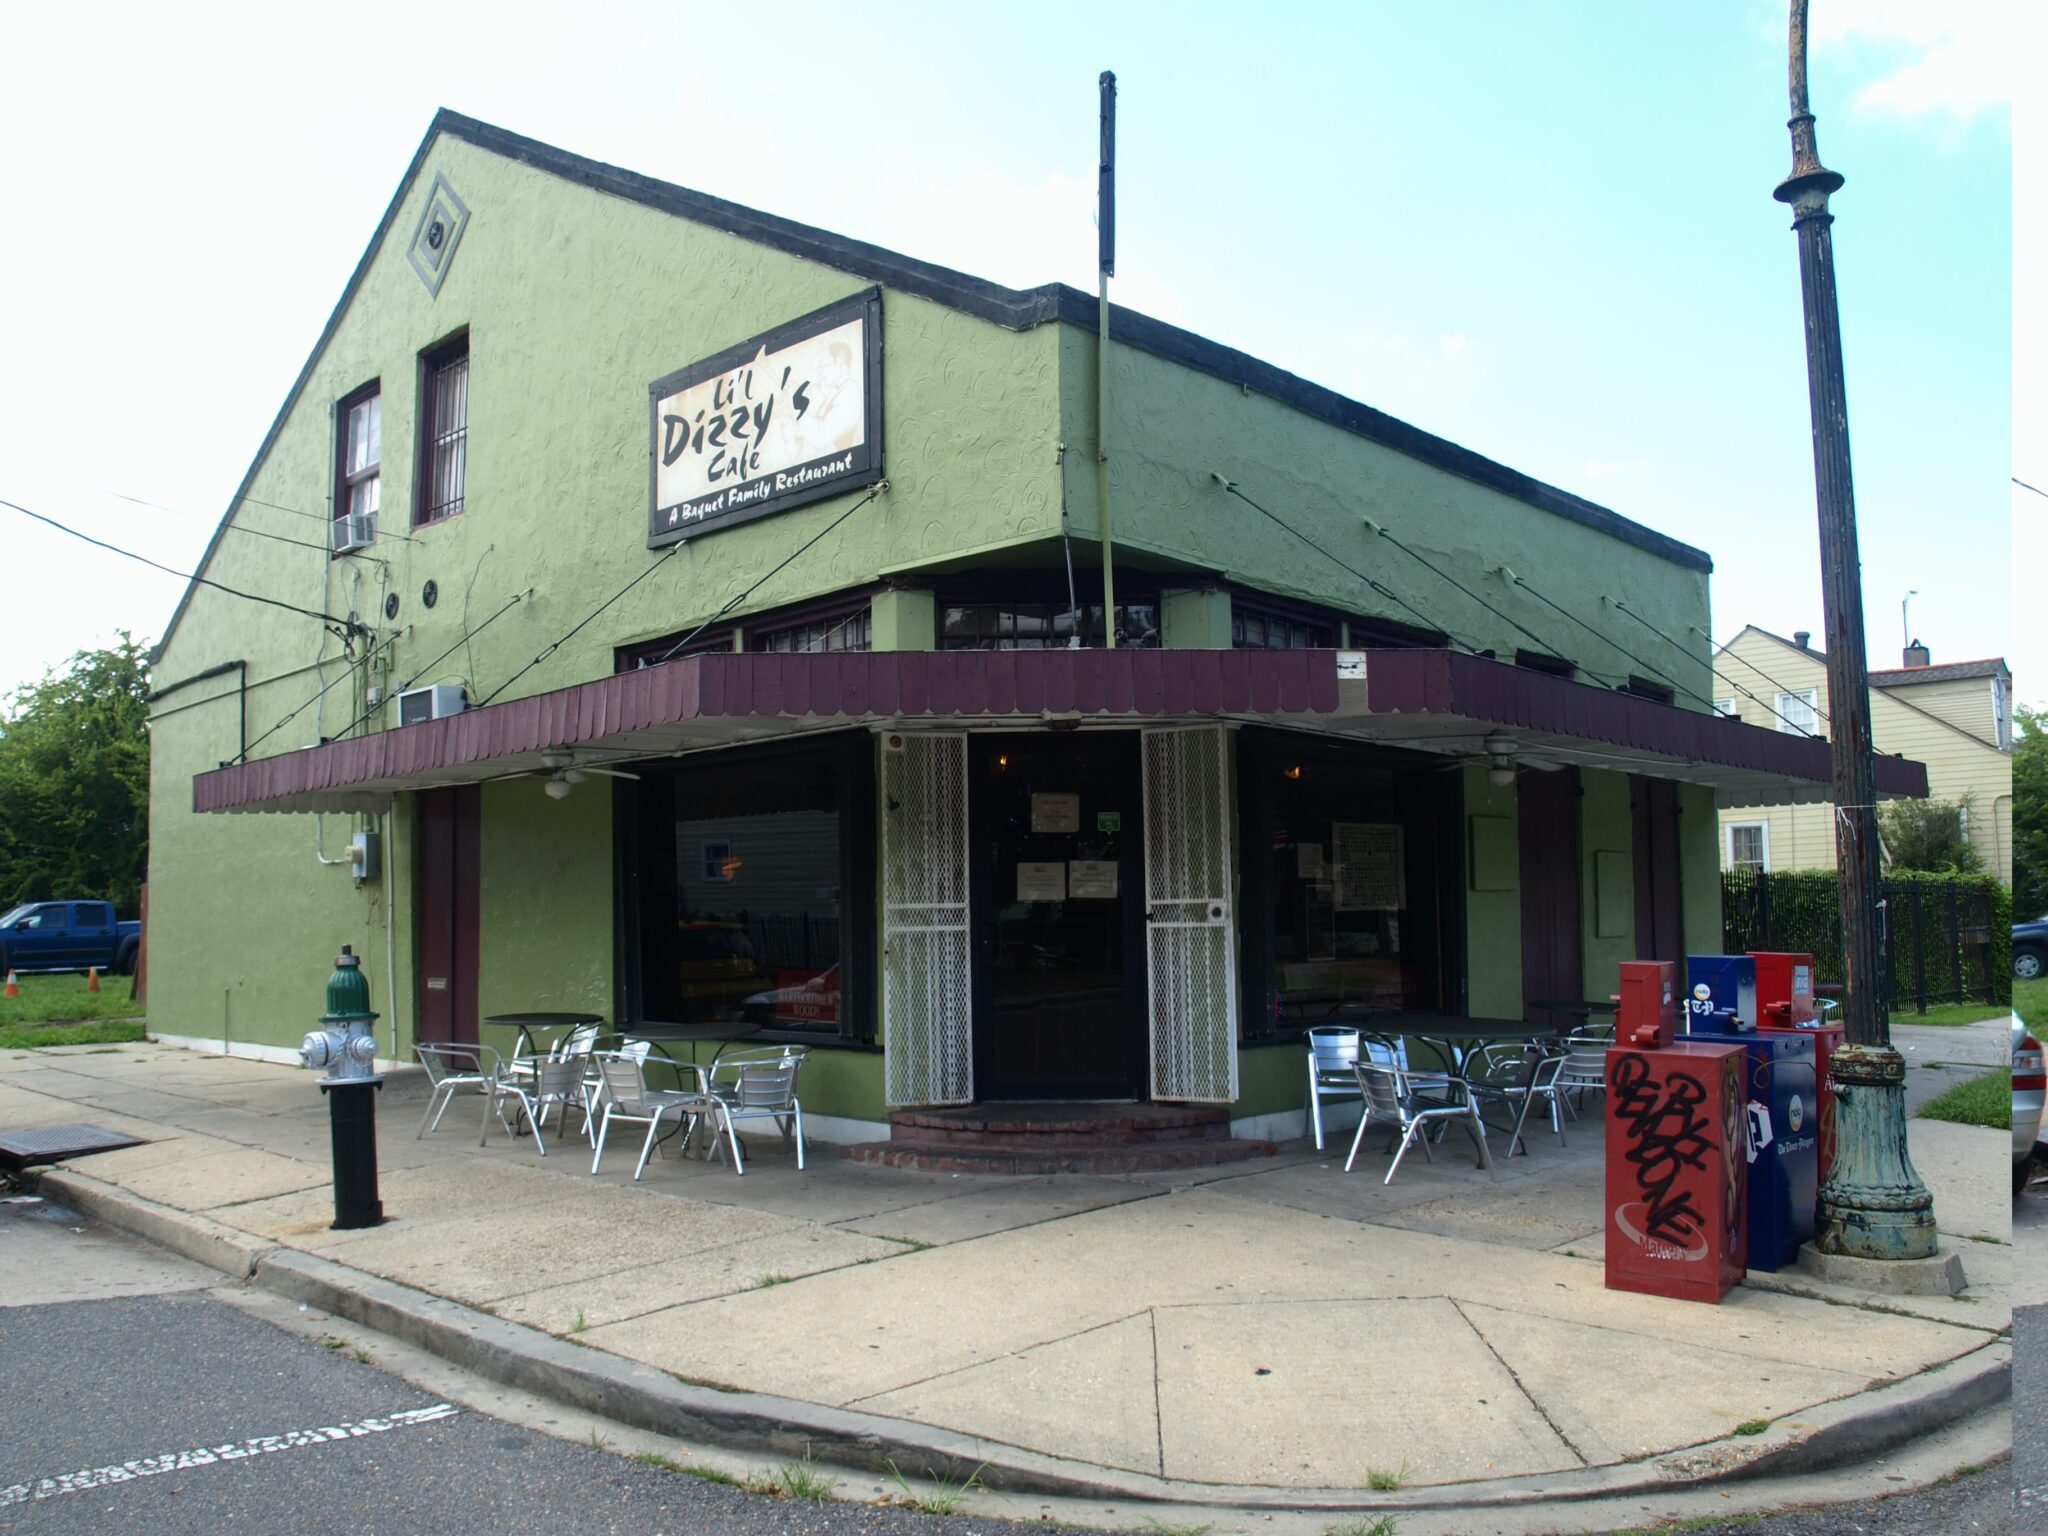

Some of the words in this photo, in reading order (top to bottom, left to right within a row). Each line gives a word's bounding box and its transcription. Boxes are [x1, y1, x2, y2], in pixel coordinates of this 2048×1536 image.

[662, 366, 810, 467] Dizzy's
[669, 511, 678, 526] A
[682, 494, 724, 520] Baquet
[728, 480, 771, 508] Family
[775, 452, 853, 491] Restaurant
